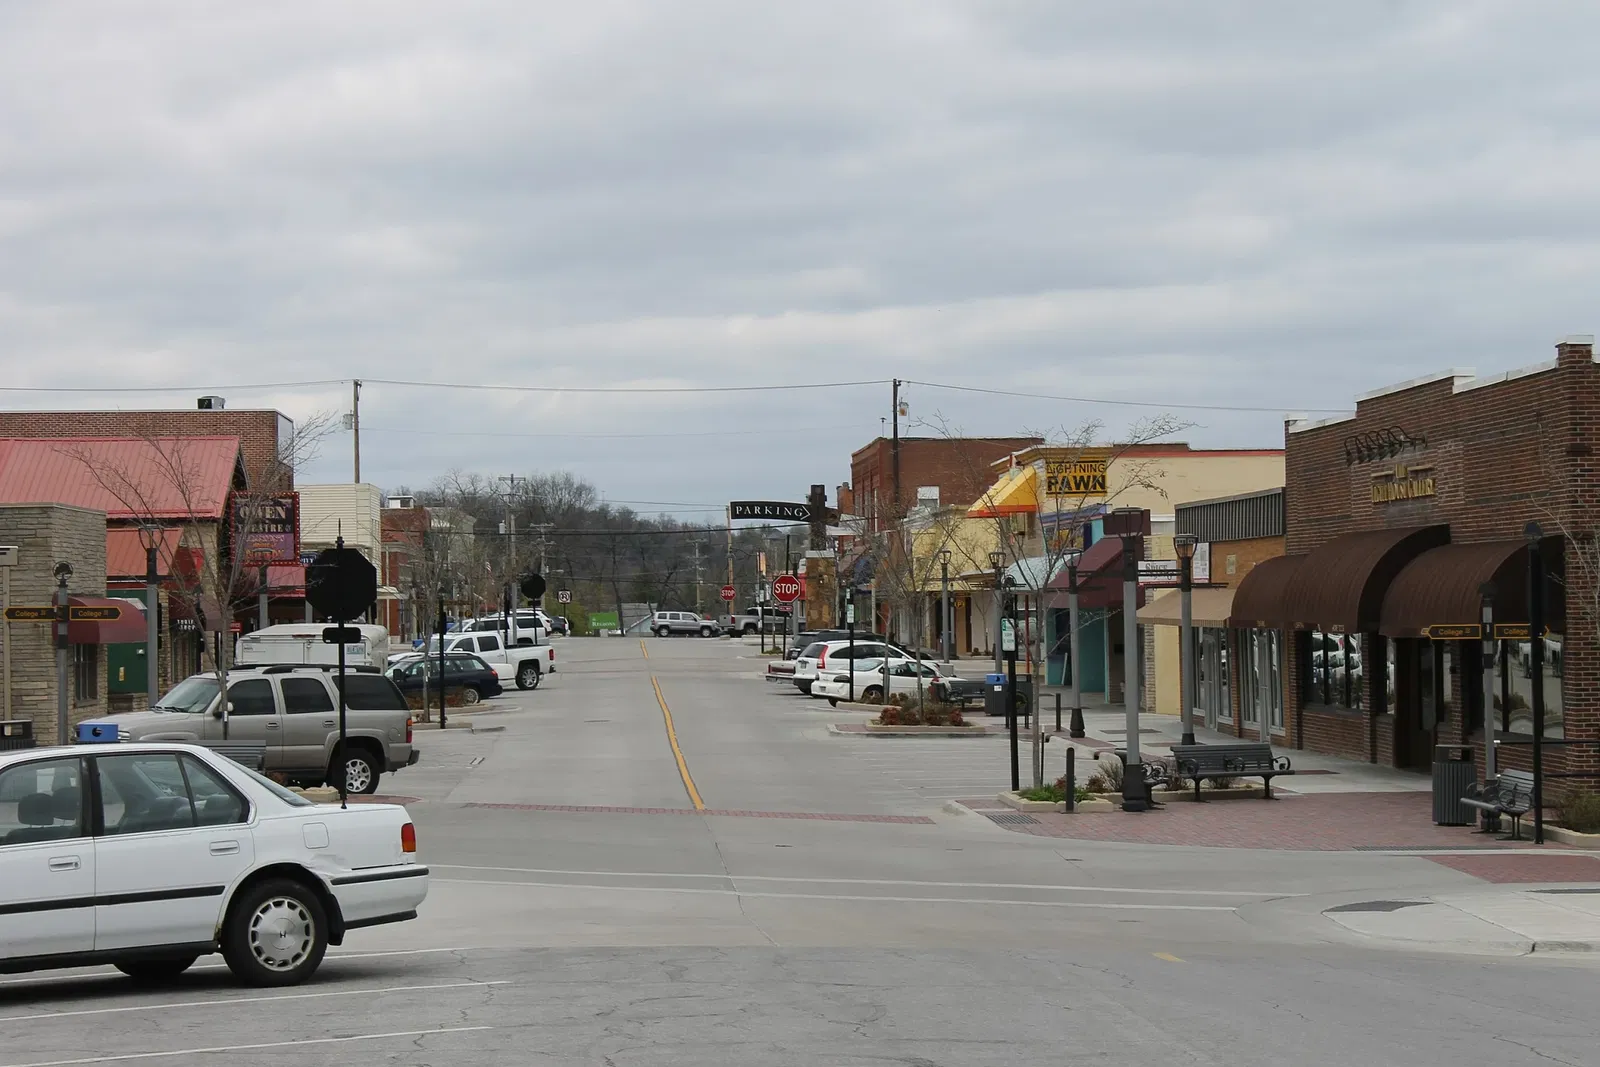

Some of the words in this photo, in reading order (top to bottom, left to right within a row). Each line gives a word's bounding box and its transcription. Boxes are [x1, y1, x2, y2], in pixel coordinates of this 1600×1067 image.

[1046, 463, 1105, 474] LIGHTNING
[1046, 475, 1106, 491] PAWN
[735, 505, 803, 517] PARKING
[236, 524, 283, 533] TEATRE
[775, 583, 798, 594] STOP
[15, 610, 38, 618] College
[78, 610, 102, 618] College
[1438, 628, 1463, 637] College
[1503, 628, 1528, 636] College
